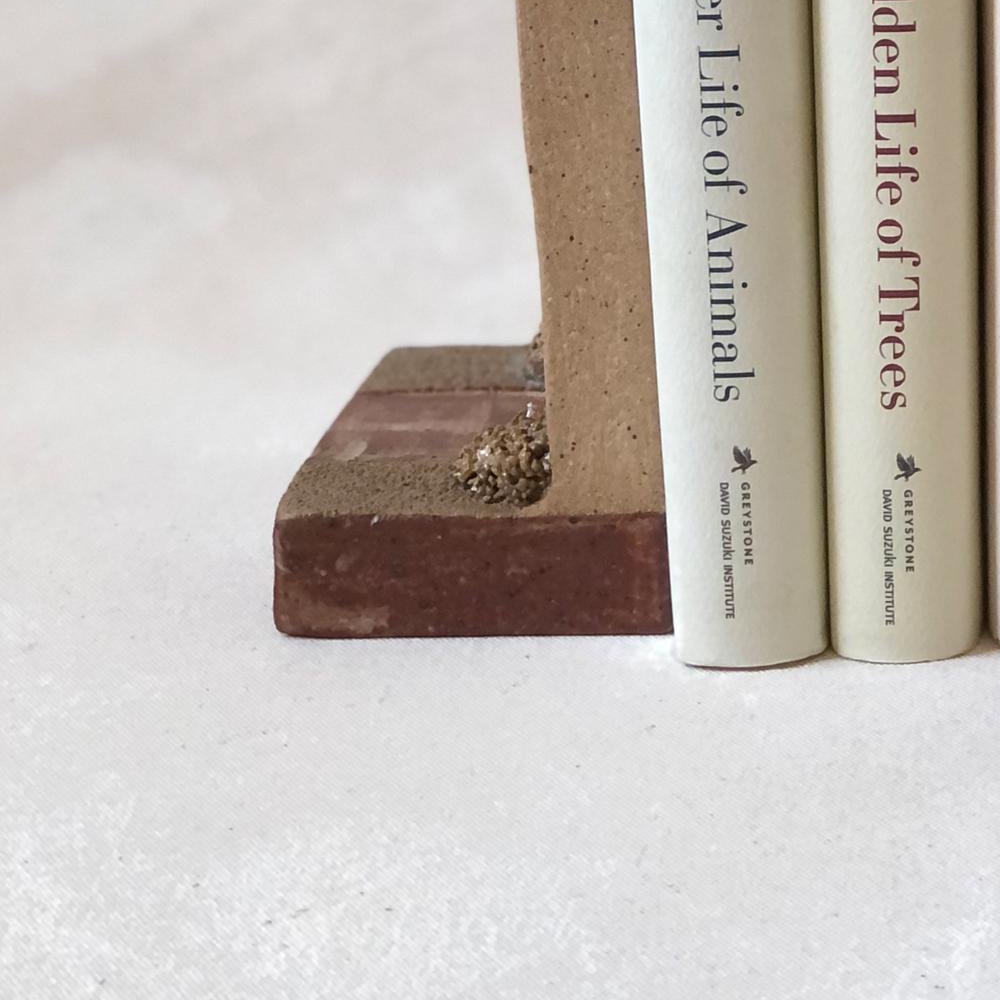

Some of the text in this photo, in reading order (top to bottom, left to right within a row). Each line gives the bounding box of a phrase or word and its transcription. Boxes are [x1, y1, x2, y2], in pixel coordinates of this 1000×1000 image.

[698, 44, 745, 138] Life
[702, 151, 748, 195] of
[874, 109, 919, 206] Life
[876, 218, 921, 268] of
[706, 209, 755, 402] Animals
[878, 276, 921, 411] Trees
[720, 482, 731, 516] DAVID
[741, 482, 754, 565] GREYSTONE
[882, 489, 893, 522] DAVID
[904, 489, 915, 573] GREYSTONE
[723, 565, 735, 620] INSTITUTE
[884, 571, 895, 626] INSTITUTE
